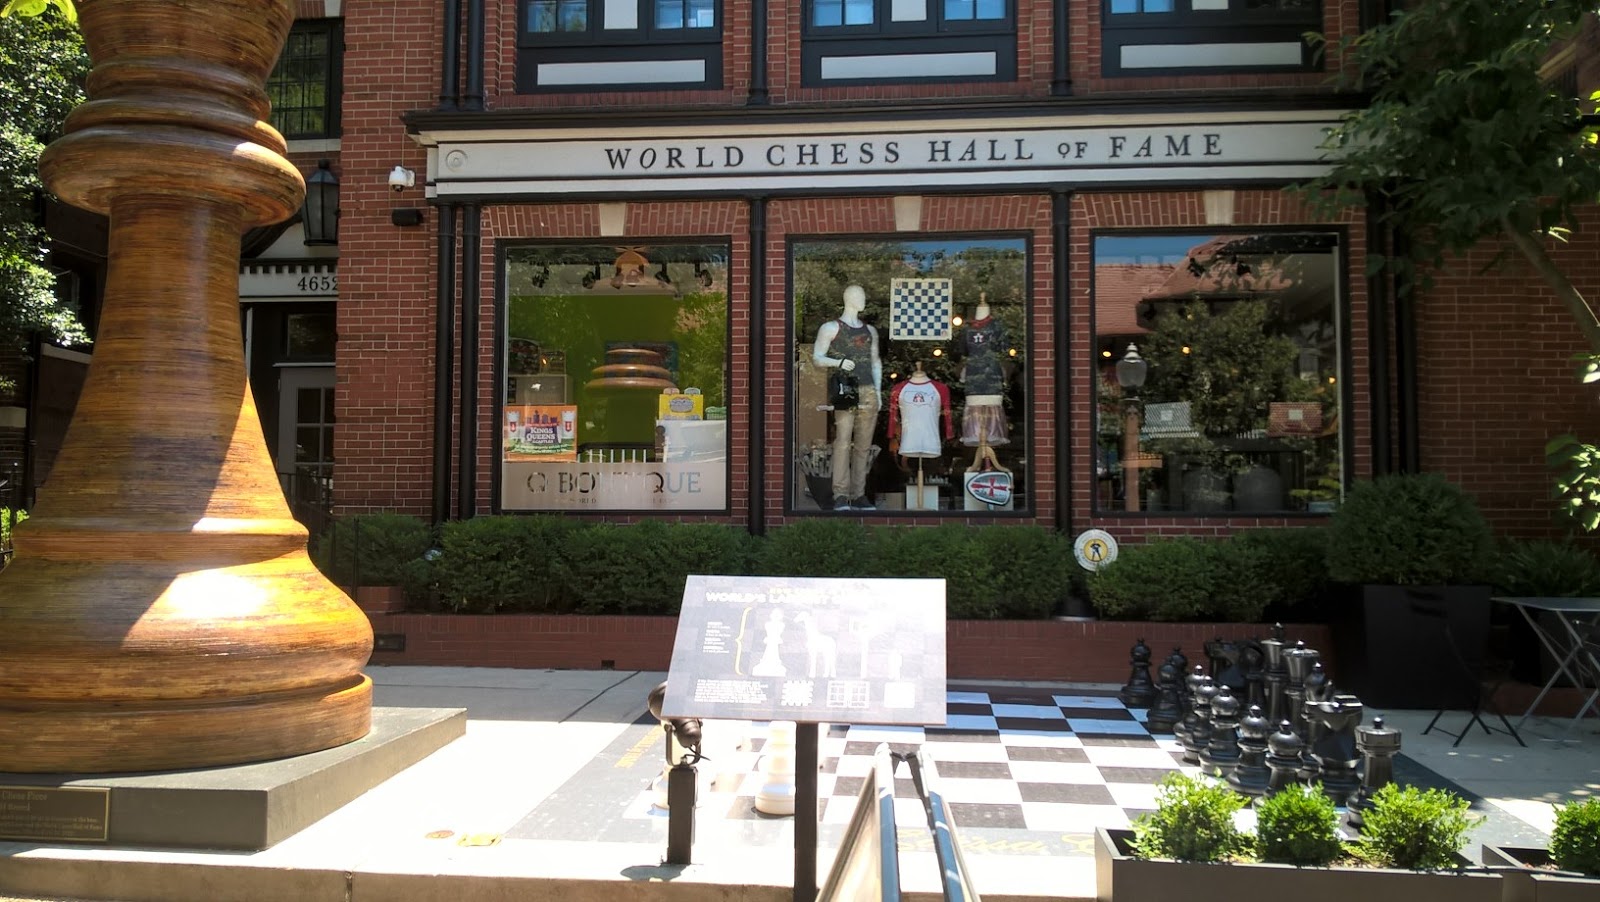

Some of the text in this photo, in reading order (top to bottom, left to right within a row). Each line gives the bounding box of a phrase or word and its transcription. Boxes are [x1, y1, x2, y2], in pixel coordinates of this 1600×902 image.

[605, 133, 1222, 170] WORLD CHESS HALL OF FAME
[297, 276, 338, 291] 4652
[526, 433, 556, 442] QUEENS
[558, 471, 702, 493] BOQUE
